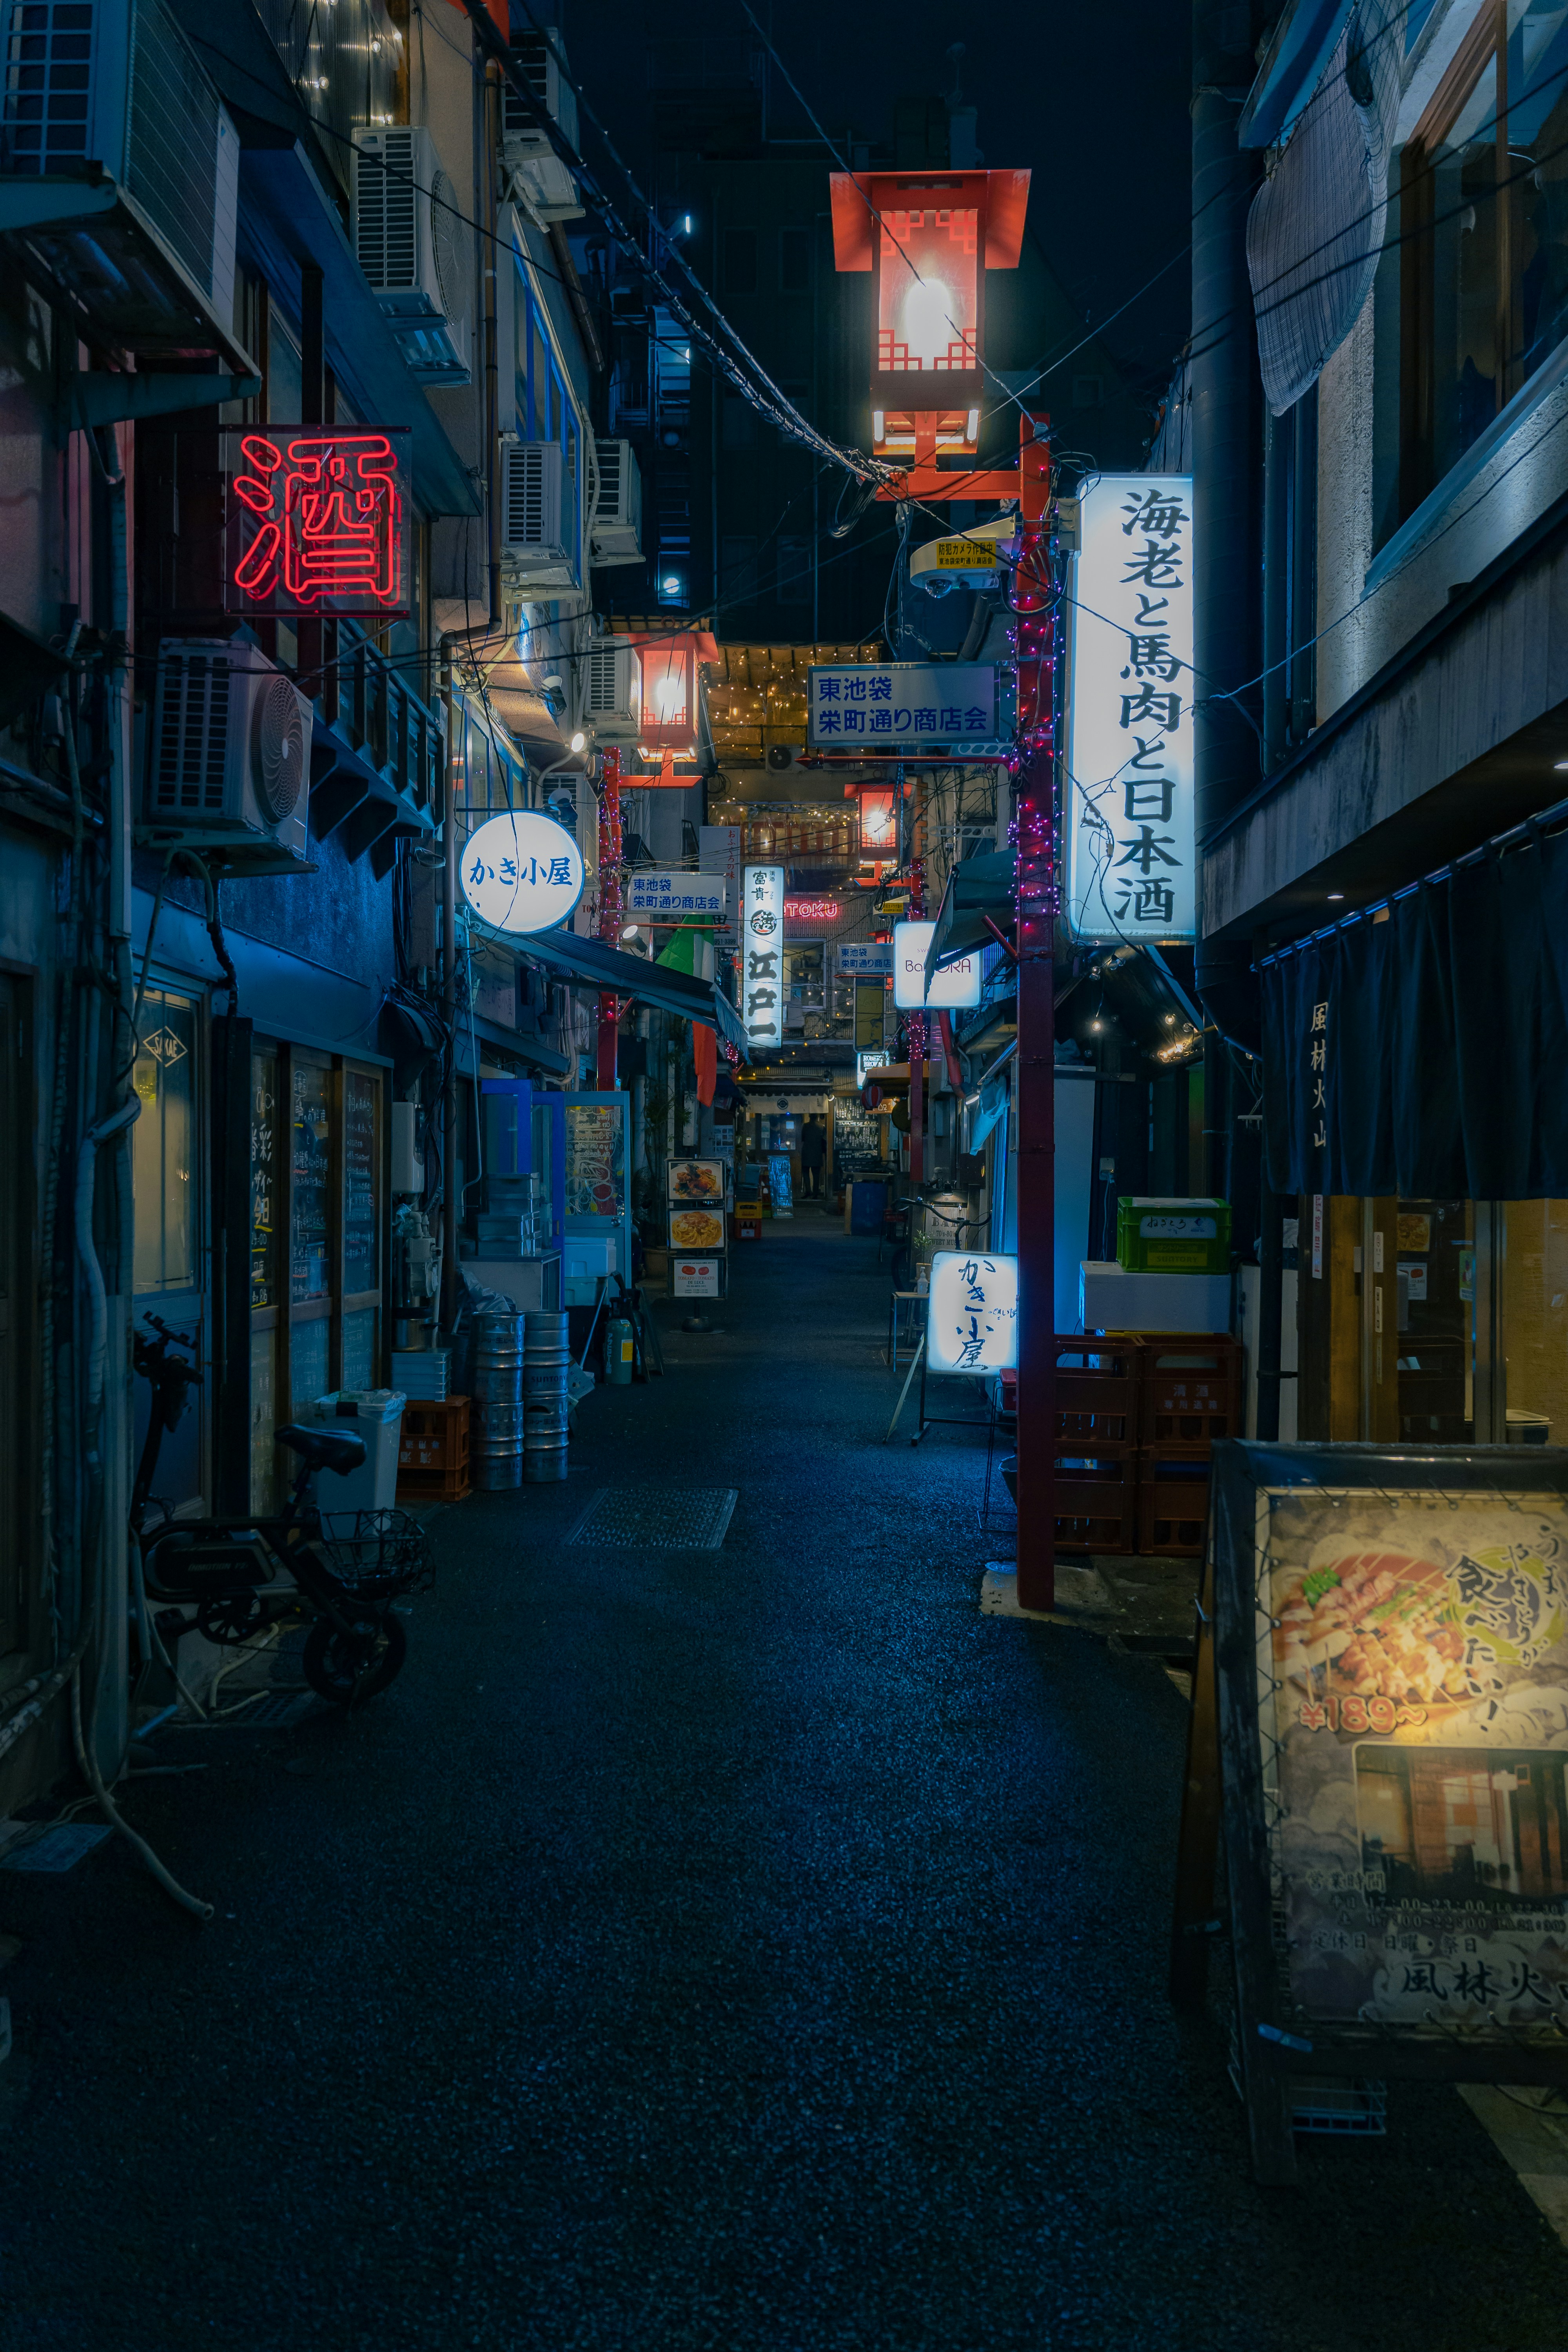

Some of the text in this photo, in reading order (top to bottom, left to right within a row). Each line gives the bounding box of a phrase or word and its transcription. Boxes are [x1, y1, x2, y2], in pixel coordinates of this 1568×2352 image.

[234, 435, 395, 596] 酒
[938, 543, 993, 555] 防犯カメラ作動中
[939, 557, 993, 565] 東池袋栄町通り商店会
[818, 677, 892, 701] 東池袋
[818, 706, 987, 734] 栄町通り商店会
[1114, 489, 1190, 924] 海老と馬肉と日本酒
[470, 857, 573, 886] かき小屋
[633, 878, 671, 891] 東池袋
[751, 870, 769, 901] 富貴
[633, 896, 720, 909] 栄町通り商店会
[841, 948, 867, 957] 東池袋
[841, 959, 894, 968] 栄町通り商店
[748, 950, 778, 1037] 江戸一
[1310, 1001, 1329, 1148] 風林火山
[953, 1259, 996, 1370] かき小屋
[1403, 1960, 1568, 2005] 風林火
